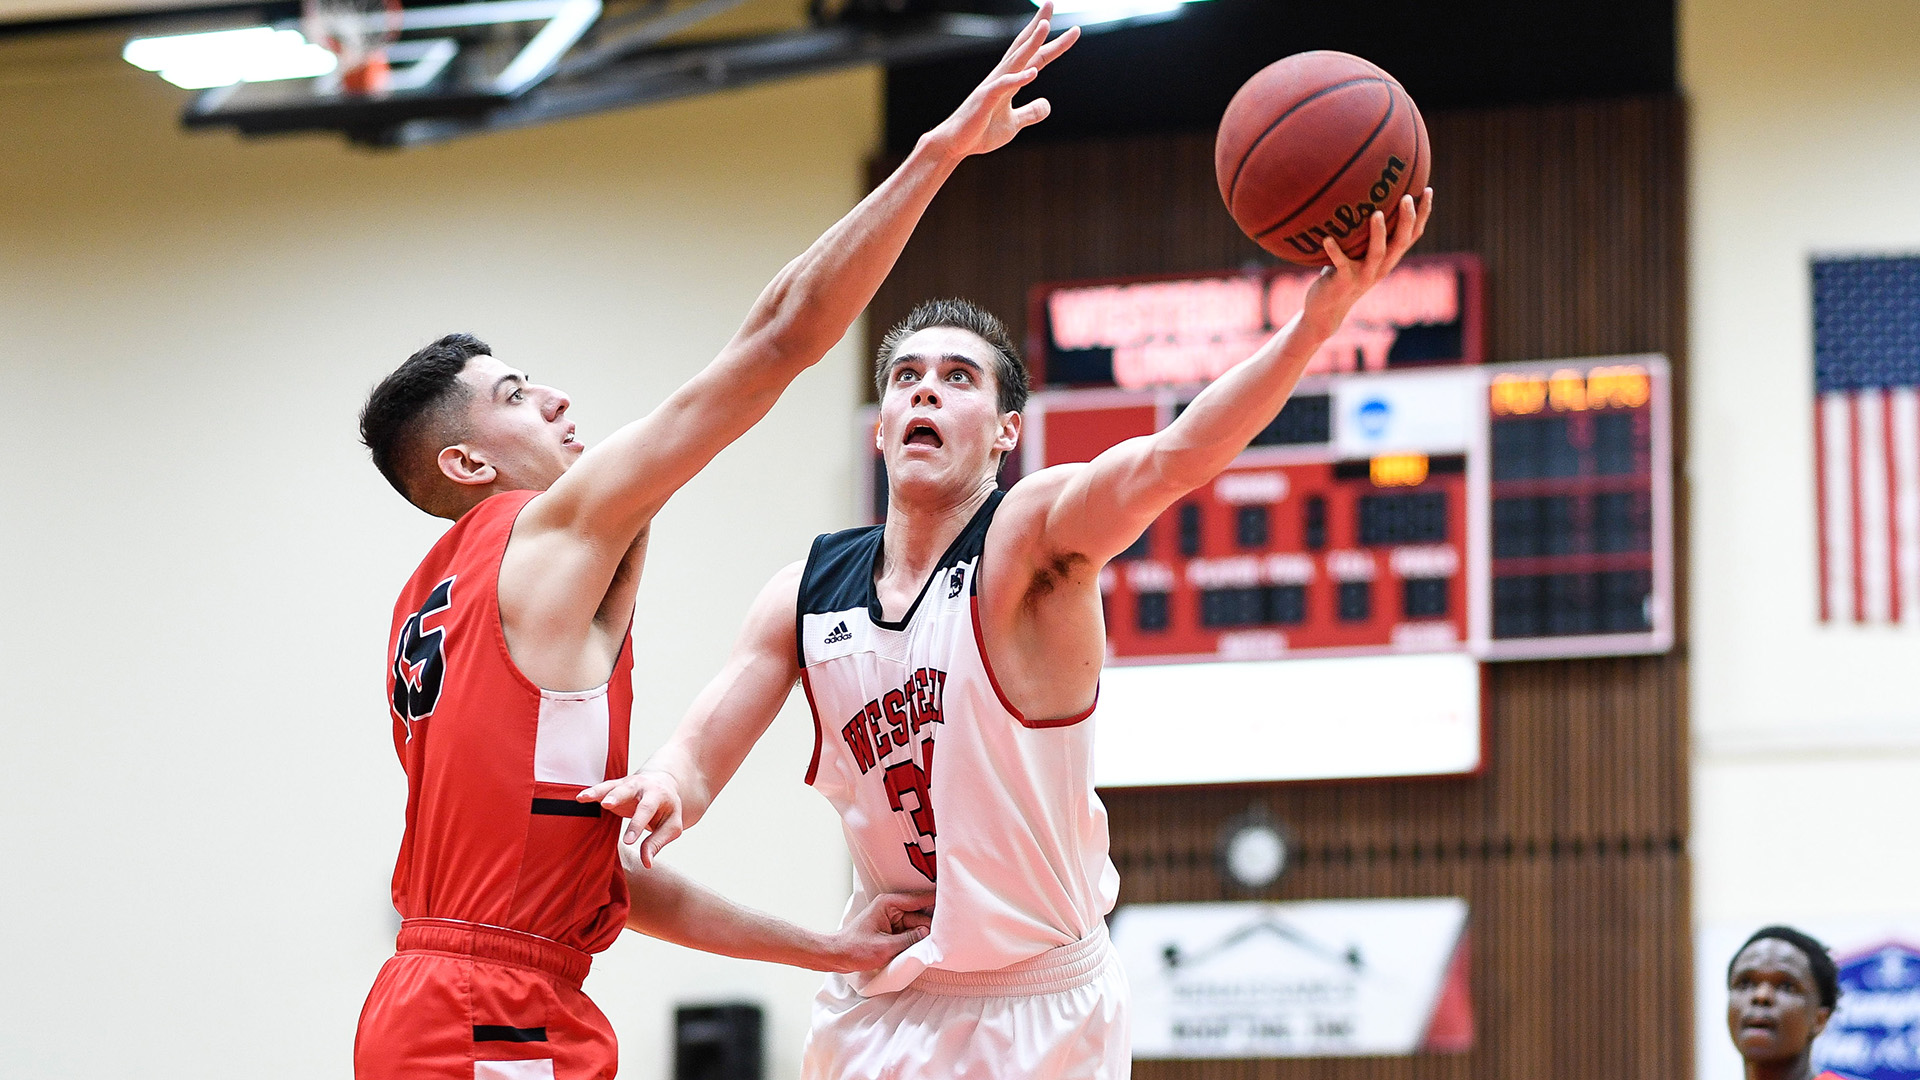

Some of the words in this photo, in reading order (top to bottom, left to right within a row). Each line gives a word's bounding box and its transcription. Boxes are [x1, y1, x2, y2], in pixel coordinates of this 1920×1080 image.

[1283, 155, 1405, 255] Wilson
[1269, 263, 1460, 330] OON
[824, 632, 852, 645] adidas
